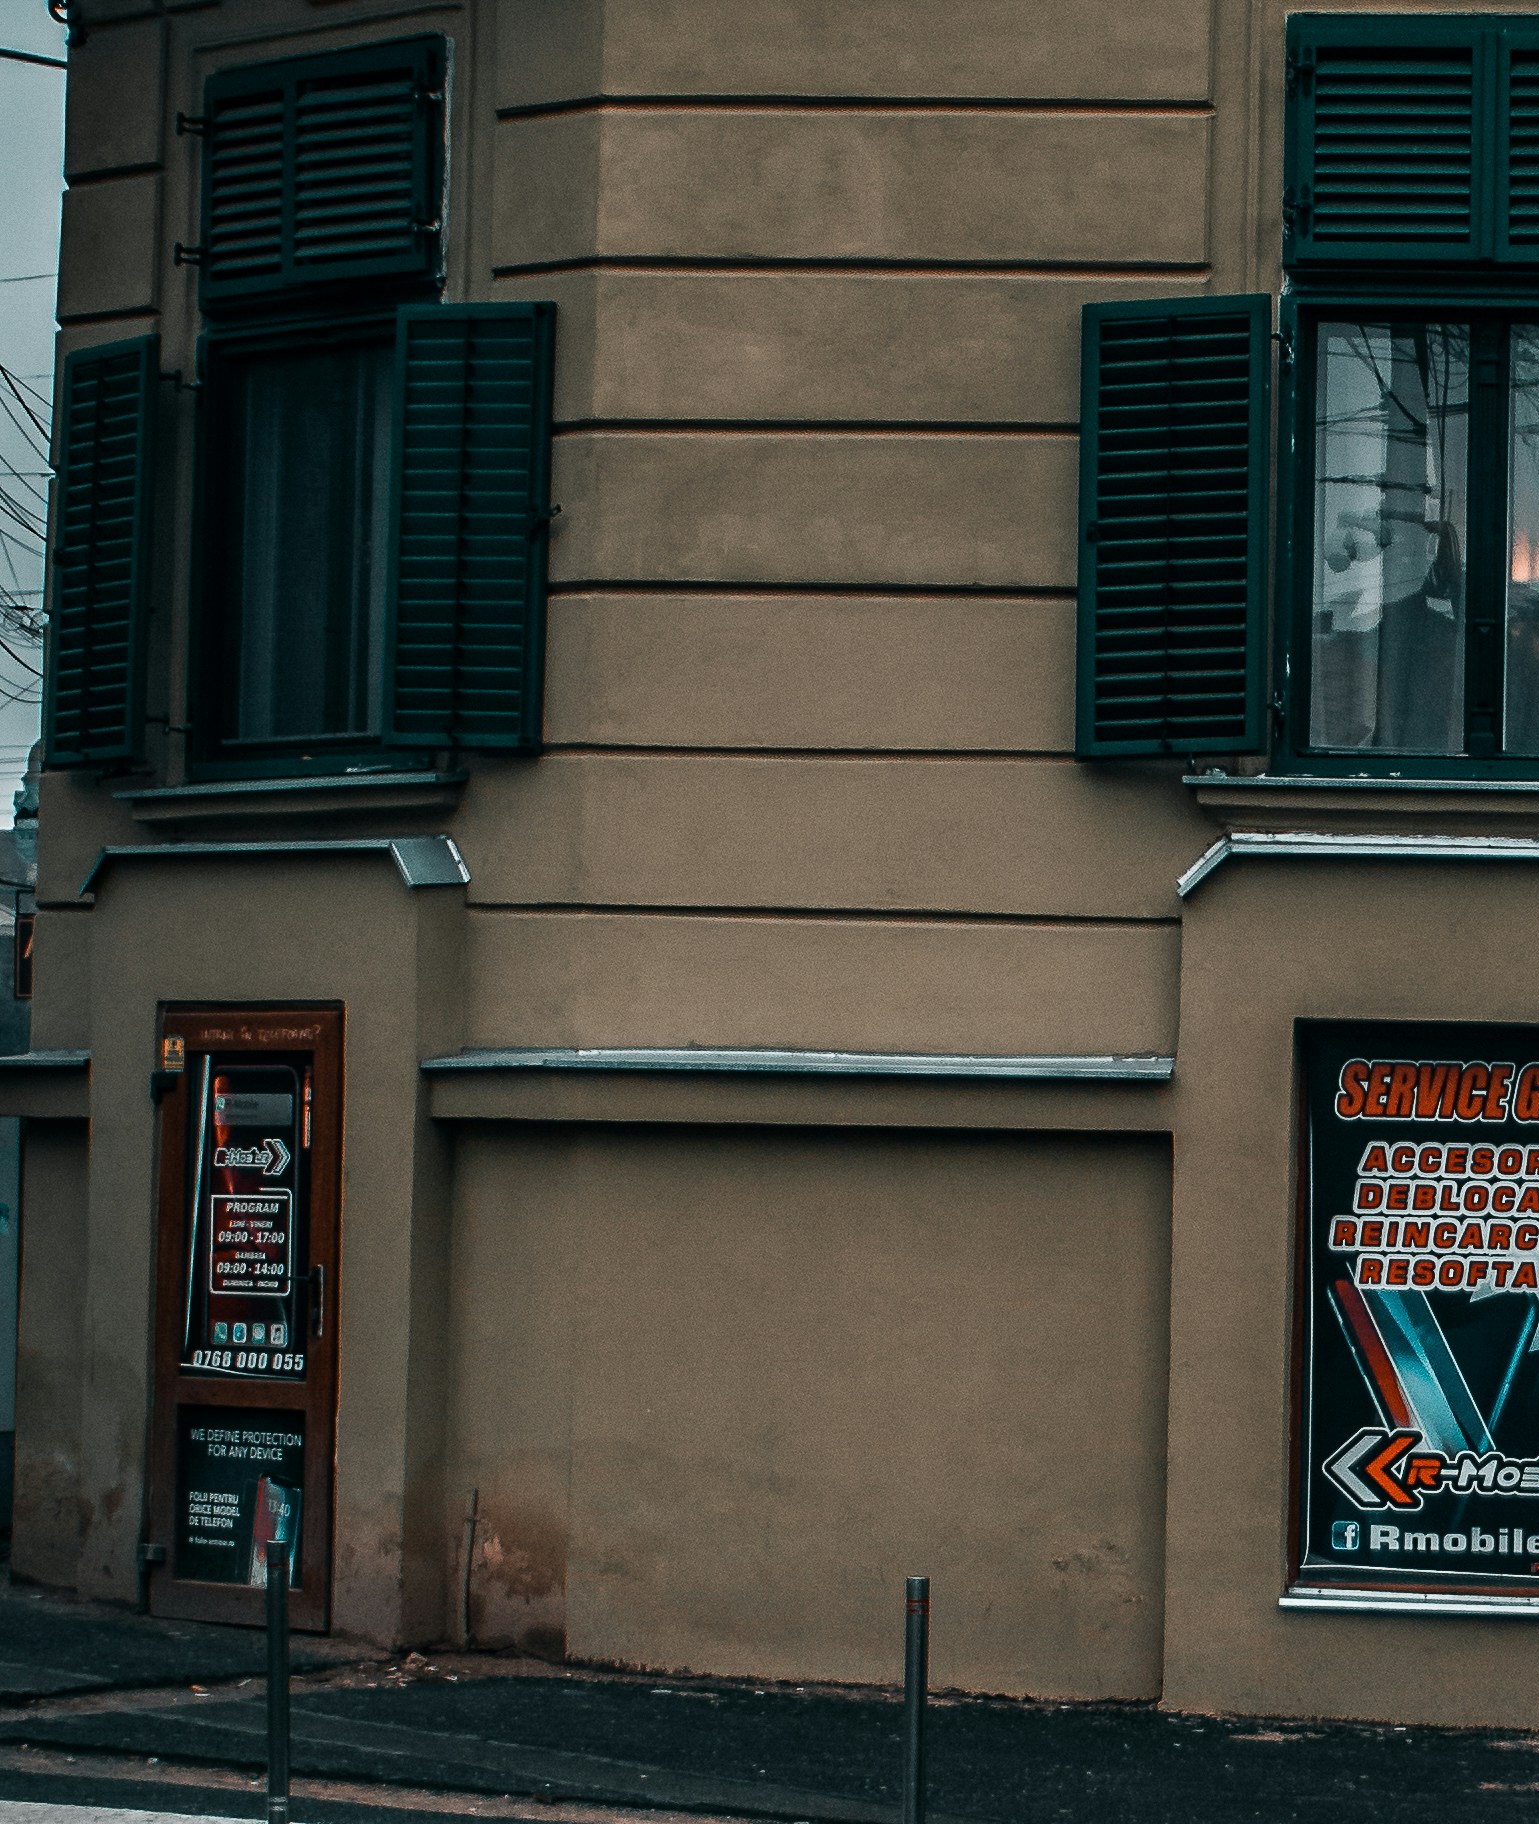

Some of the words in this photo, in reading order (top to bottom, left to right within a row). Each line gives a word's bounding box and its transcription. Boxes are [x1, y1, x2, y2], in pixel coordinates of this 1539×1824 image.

[1336, 1059, 1515, 1122] SERVICE
[226, 1202, 279, 1213] PROGRAM
[218, 1231, 248, 1243] 09:00
[255, 1231, 285, 1243] 17:00
[217, 1262, 247, 1274] 09:00
[254, 1263, 284, 1275] 14:00
[193, 1350, 231, 1367] 0768
[237, 1352, 268, 1369] 000
[273, 1353, 304, 1371] 055
[190, 1428, 206, 1441] WE
[207, 1429, 241, 1443] DEFINE
[243, 1431, 302, 1447] PROTECTION
[208, 1443, 227, 1457] FOR
[228, 1445, 248, 1458] ANY
[249, 1446, 284, 1461] DEVICE
[189, 1515, 199, 1526] DE
[200, 1516, 233, 1529] TELEFON
